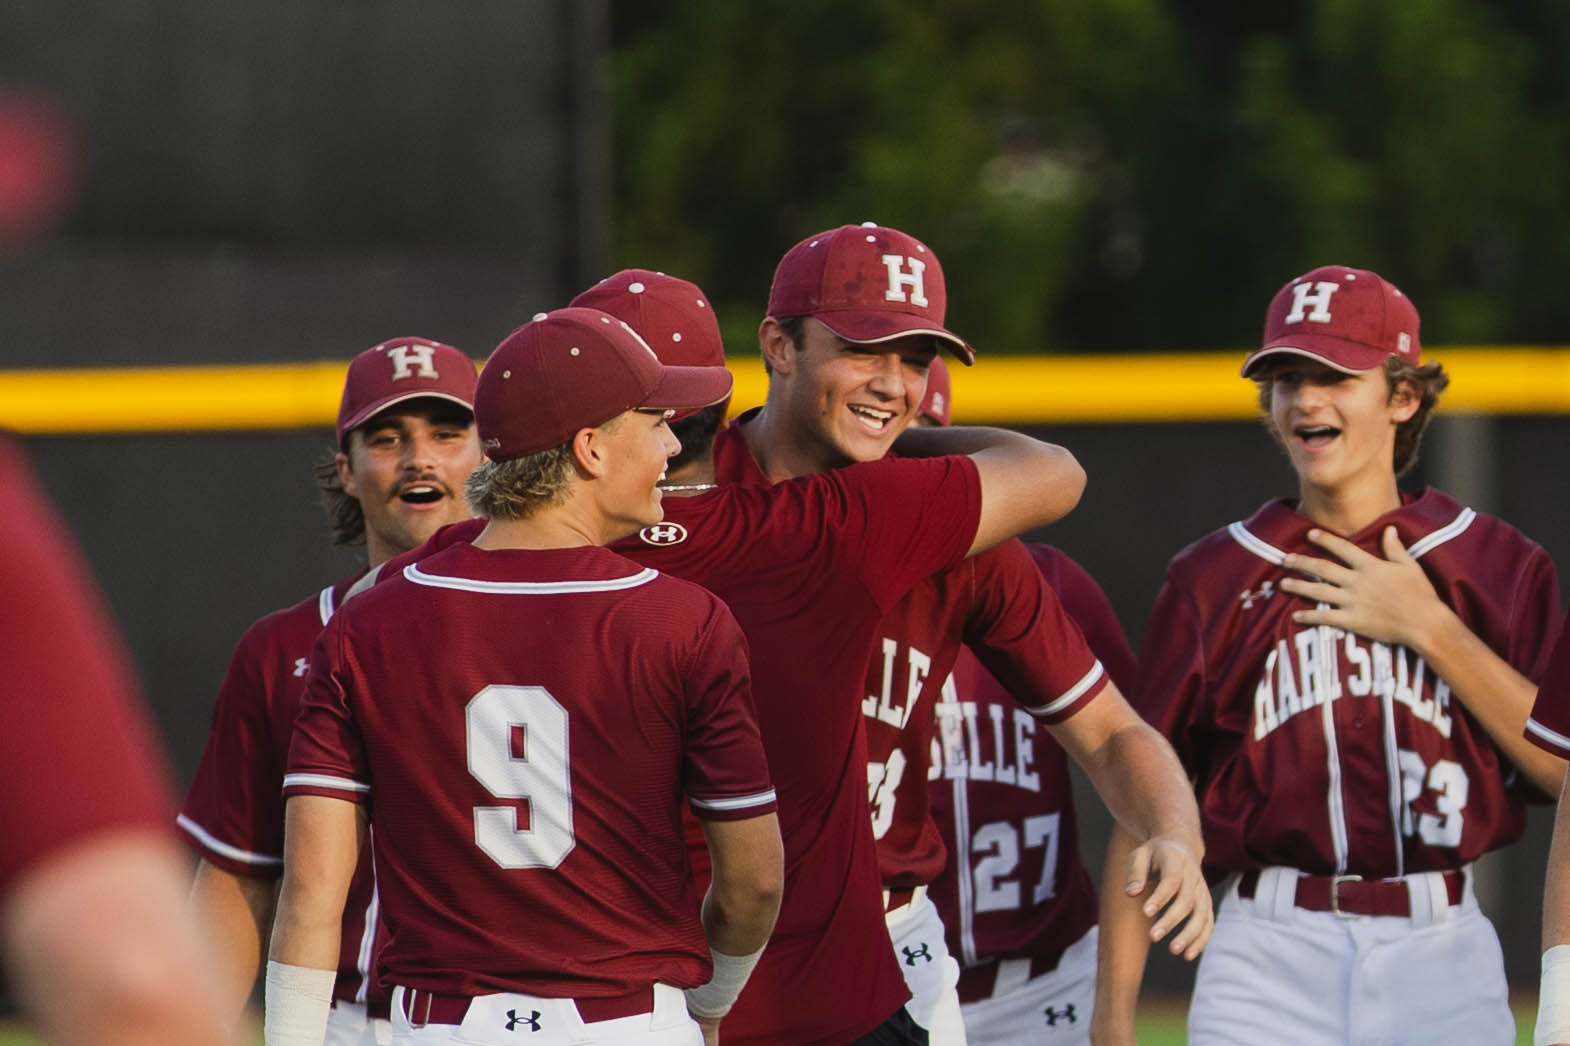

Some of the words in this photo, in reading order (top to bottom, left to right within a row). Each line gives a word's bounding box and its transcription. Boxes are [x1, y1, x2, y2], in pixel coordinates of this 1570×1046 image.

[882, 254, 930, 309] H
[1284, 281, 1340, 325] H
[387, 344, 440, 383] H
[465, 684, 578, 871] 9
[971, 812, 1061, 914] 27
